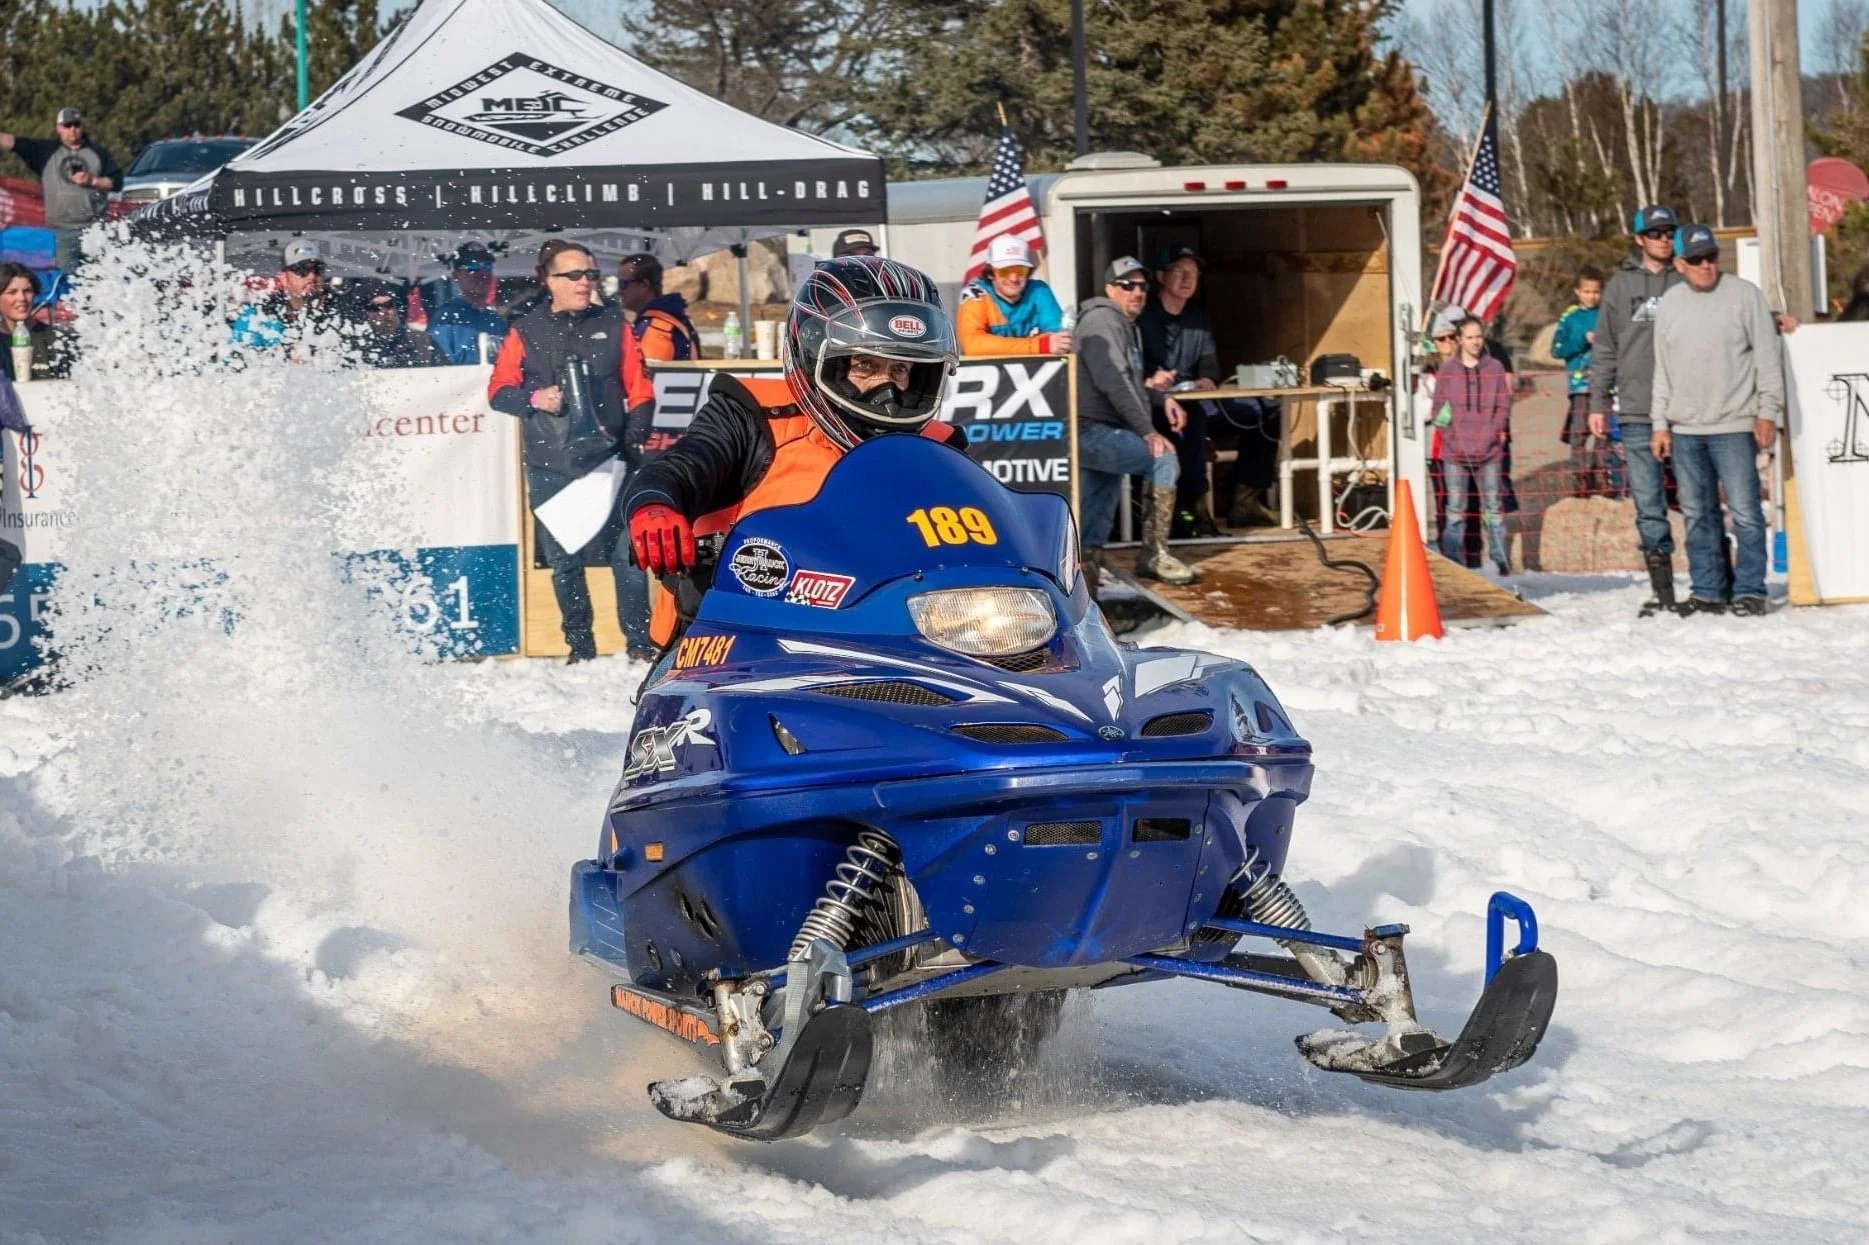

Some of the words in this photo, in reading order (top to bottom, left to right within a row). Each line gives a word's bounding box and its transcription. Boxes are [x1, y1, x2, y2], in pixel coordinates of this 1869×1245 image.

[424, 61, 515, 110] MIDWEST
[528, 60, 637, 103] EXTREME
[420, 115, 539, 155] SNOWMOBILE
[549, 106, 650, 153] CHALLENGE
[233, 186, 407, 207] HILLCROSS
[470, 184, 640, 204] HILLCLIMB
[702, 180, 870, 200] HILL-DRAG
[894, 320, 922, 331] BELL
[965, 421, 1065, 442] OWER
[905, 506, 998, 548] 189
[793, 576, 846, 602] KLOTZ
[675, 634, 737, 669] CM7481
